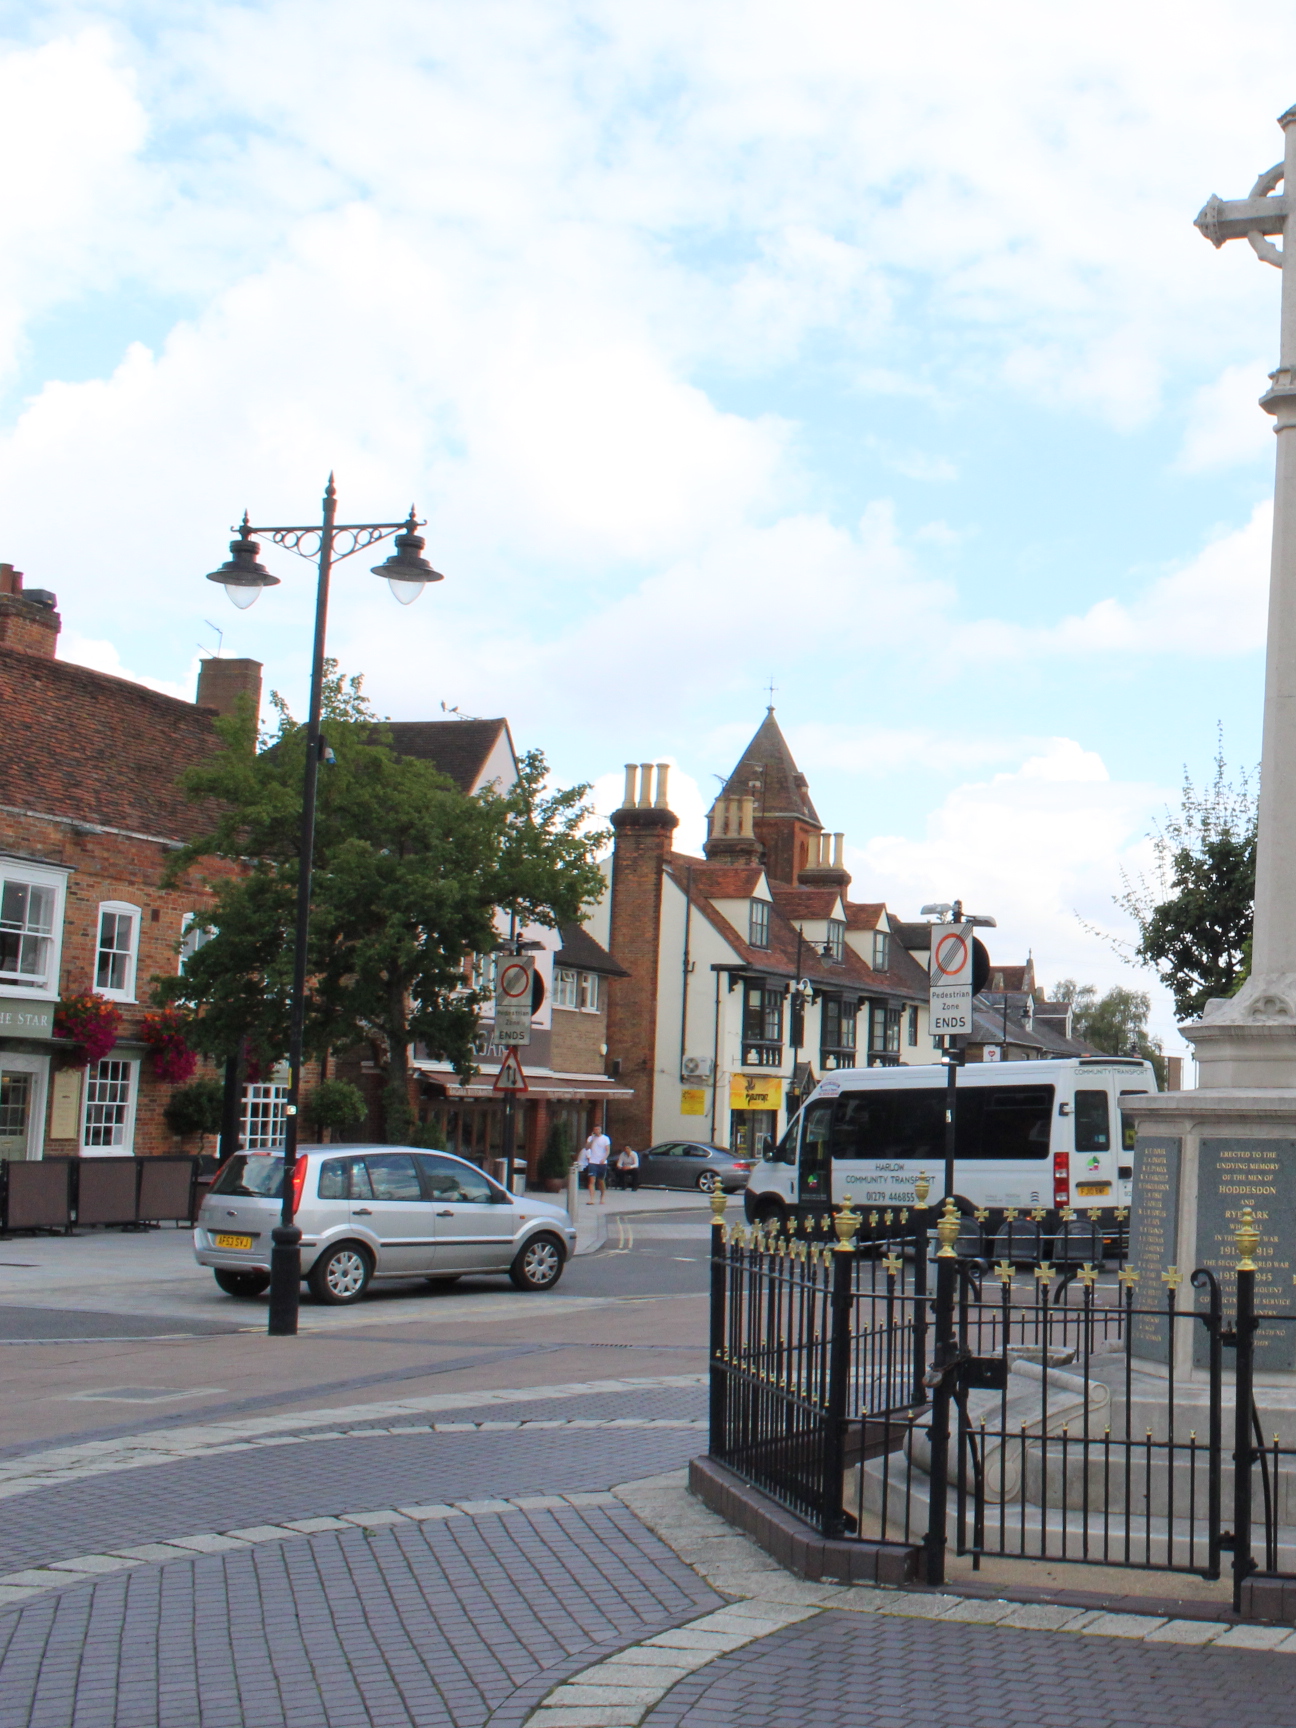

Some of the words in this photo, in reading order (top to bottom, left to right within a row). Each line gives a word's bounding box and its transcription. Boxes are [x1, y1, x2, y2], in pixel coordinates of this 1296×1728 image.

[932, 991, 970, 999] Pedestrian
[18, 1014, 48, 1026] STAR
[935, 1017, 966, 1028] ENDS
[499, 1031, 525, 1040] ENDS
[1074, 1068, 1111, 1076] COMMUNITY
[1112, 1068, 1148, 1076] TRANSPORT
[876, 1163, 905, 1172] HARLOW
[846, 1175, 888, 1184] COMMUNITY
[1219, 1186, 1276, 1194] HODDESDON
[866, 1192, 886, 1202] 01279
[888, 1192, 915, 1202] 446855
[1225, 1210, 1243, 1218] RYE
